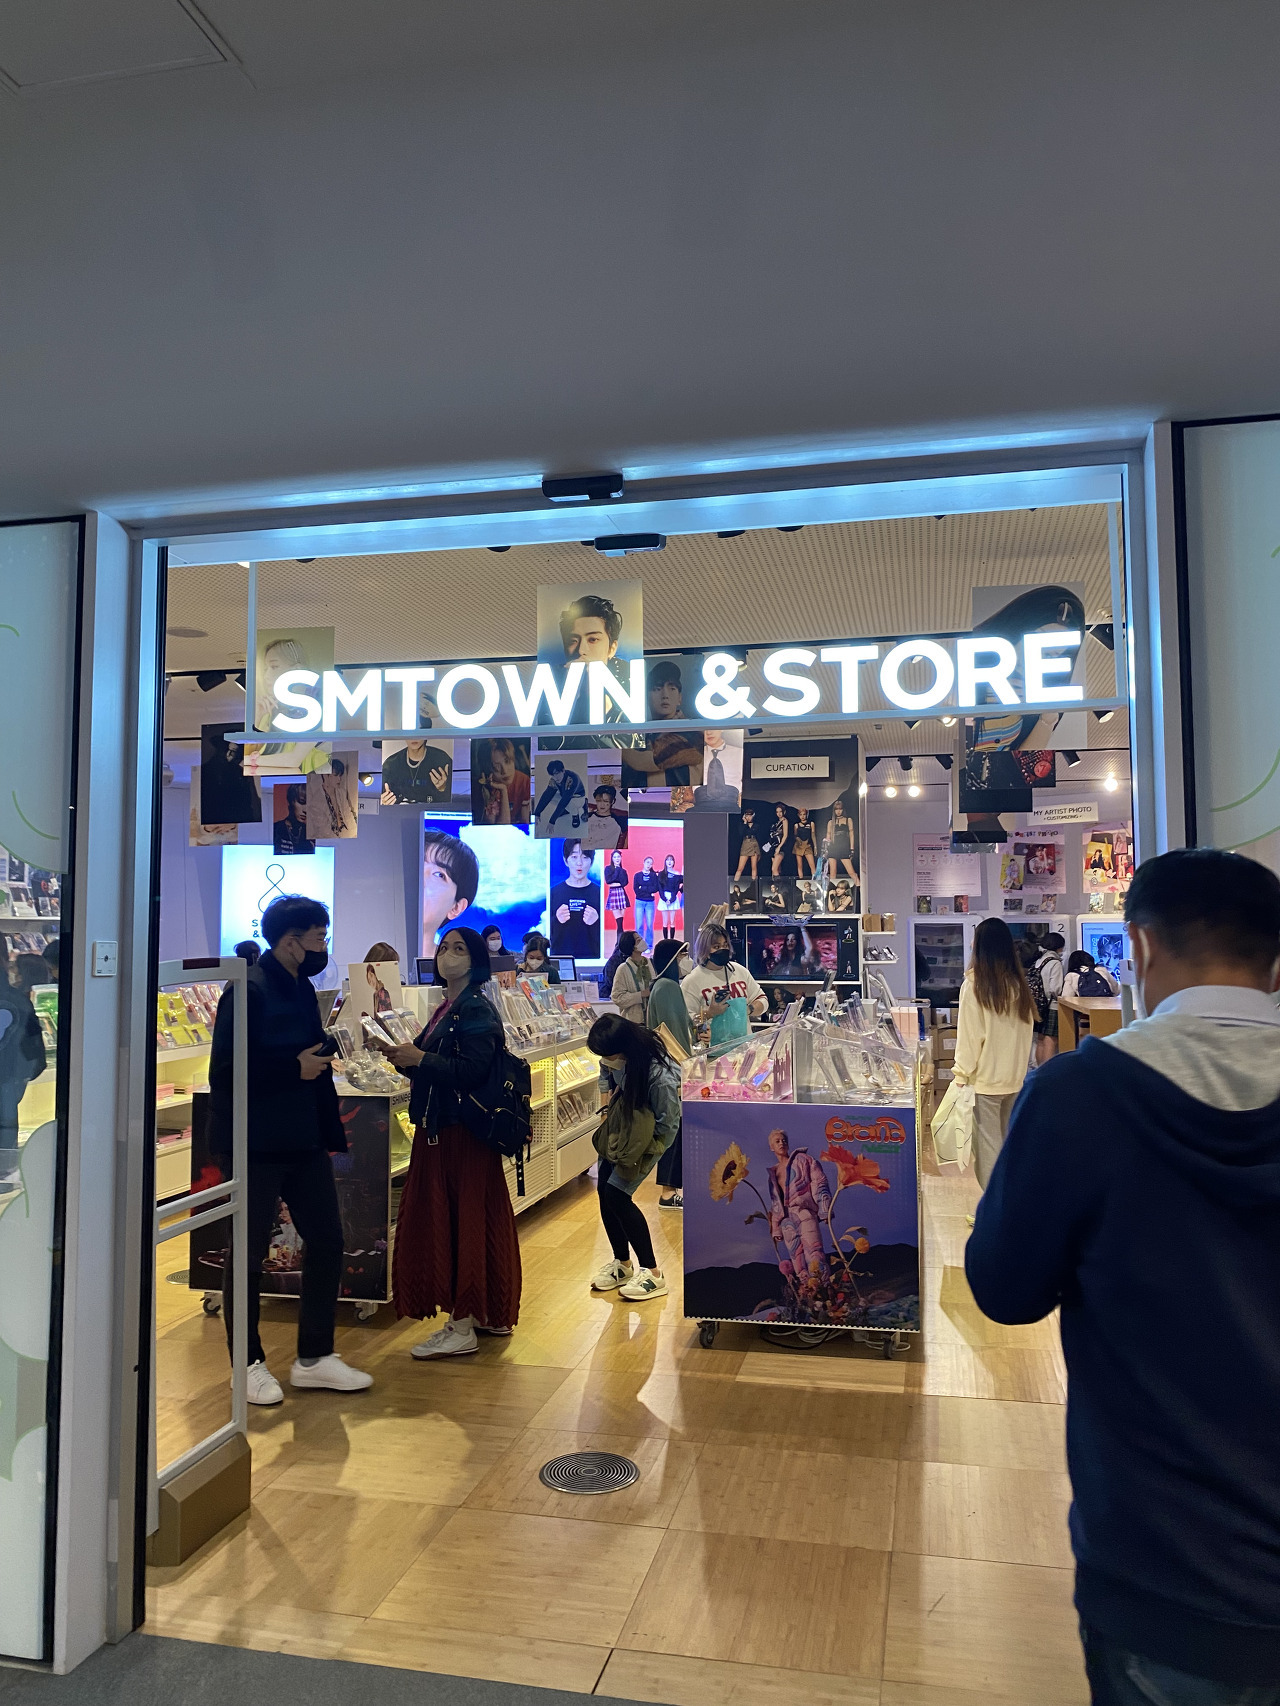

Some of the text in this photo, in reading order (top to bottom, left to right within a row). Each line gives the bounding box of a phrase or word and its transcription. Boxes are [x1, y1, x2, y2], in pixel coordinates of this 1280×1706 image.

[271, 659, 647, 733] SMTOWN
[765, 763, 815, 772] CURATION
[1057, 923, 1065, 932] 2
